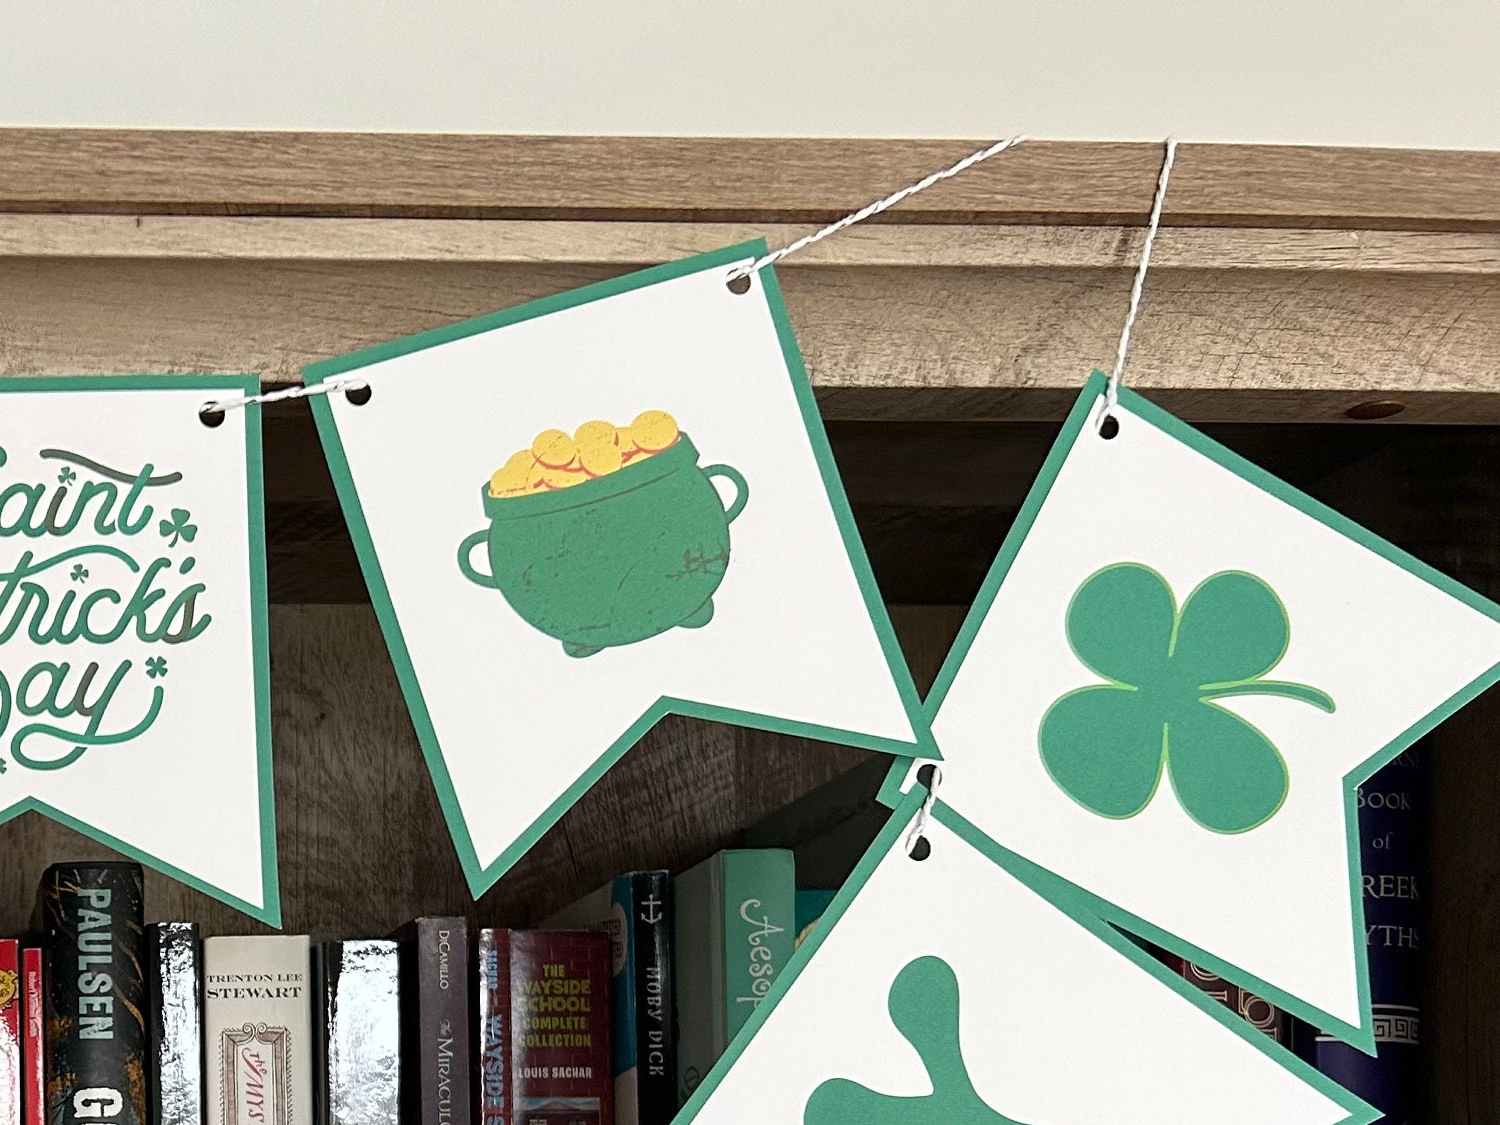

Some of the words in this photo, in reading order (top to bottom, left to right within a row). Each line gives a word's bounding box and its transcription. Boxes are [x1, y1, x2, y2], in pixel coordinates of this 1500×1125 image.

[77, 888, 114, 1040] PAULSEN
[543, 964, 565, 977] THE
[206, 974, 273, 983] TRENTON
[277, 973, 303, 982] LEE
[206, 986, 302, 1000] STEWART
[521, 979, 591, 994] WAYSIDE
[646, 966, 663, 1021] MOBY
[520, 997, 591, 1012] SCHOOL
[523, 1016, 587, 1030] COMPLETE
[520, 1034, 592, 1047] COLLECTION
[648, 1030, 665, 1076] DICK
[485, 1014, 505, 1108] WAYSIDE
[518, 1066, 548, 1078] LOUIS
[551, 1066, 592, 1078] SACHAR
